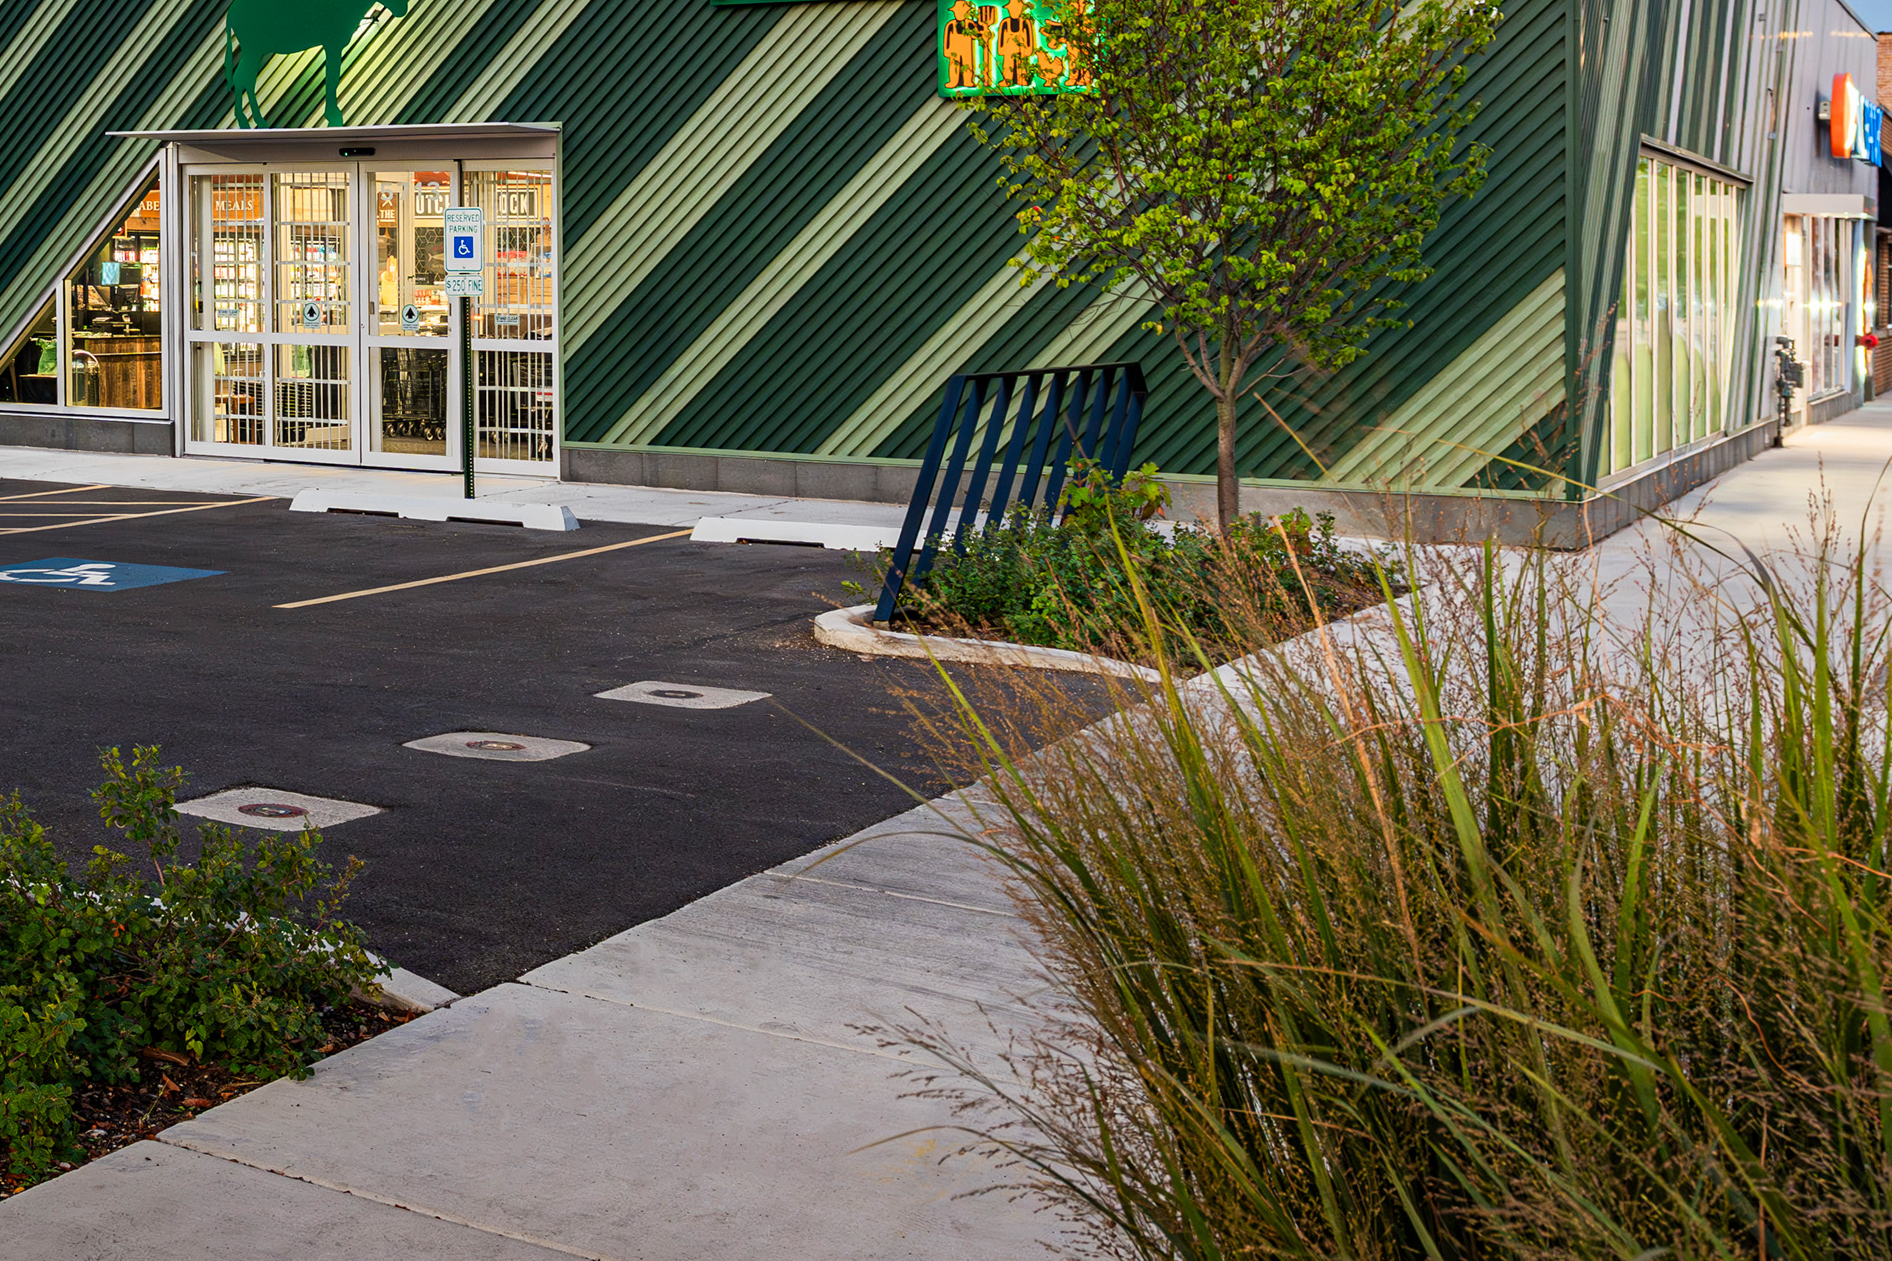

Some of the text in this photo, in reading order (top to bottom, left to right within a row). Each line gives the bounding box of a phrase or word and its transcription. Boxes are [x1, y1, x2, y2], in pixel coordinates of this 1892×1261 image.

[380, 181, 440, 201] 5713
[215, 200, 254, 211] MEALS
[379, 209, 395, 219] THE
[446, 214, 480, 223] RESERVED
[448, 225, 478, 233] PARKING
[468, 279, 483, 292] FINE
